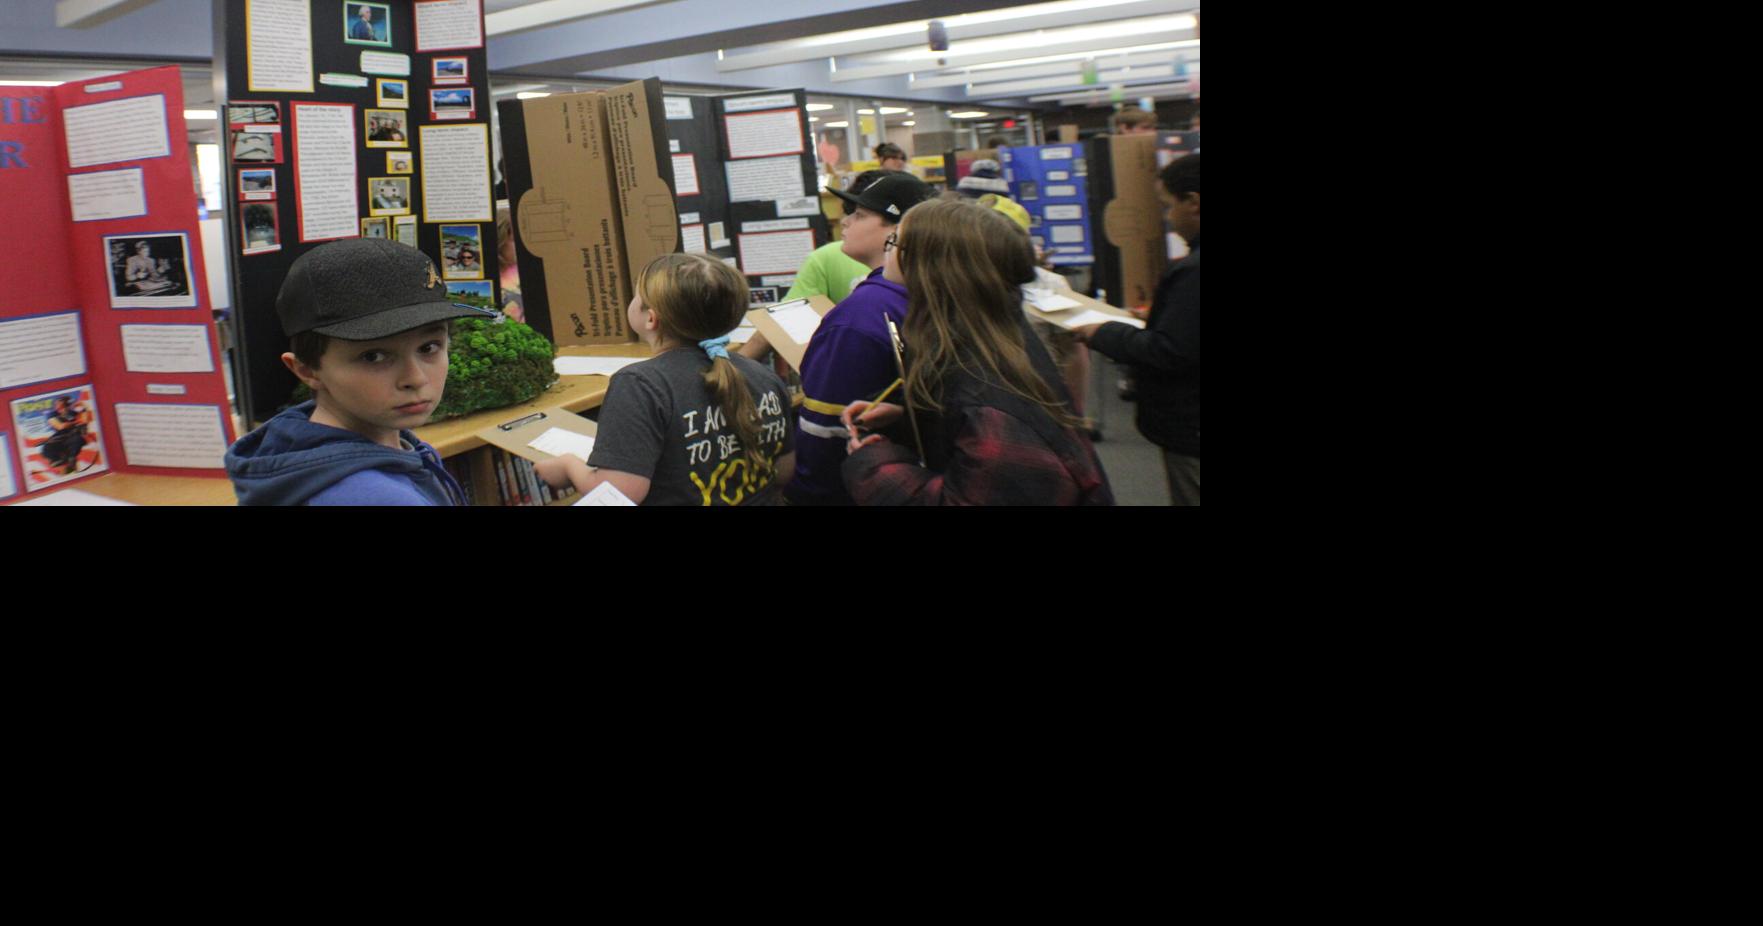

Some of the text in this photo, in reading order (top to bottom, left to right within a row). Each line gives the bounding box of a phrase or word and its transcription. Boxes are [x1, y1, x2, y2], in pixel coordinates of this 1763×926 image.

[600, 219, 610, 246] battants
[580, 248, 591, 268] Board
[593, 244, 607, 294] presentaciones
[604, 248, 613, 264] trois
[585, 270, 597, 312] Presentation
[682, 410, 699, 438] I
[686, 439, 712, 465] TO
[717, 433, 742, 460] BE
